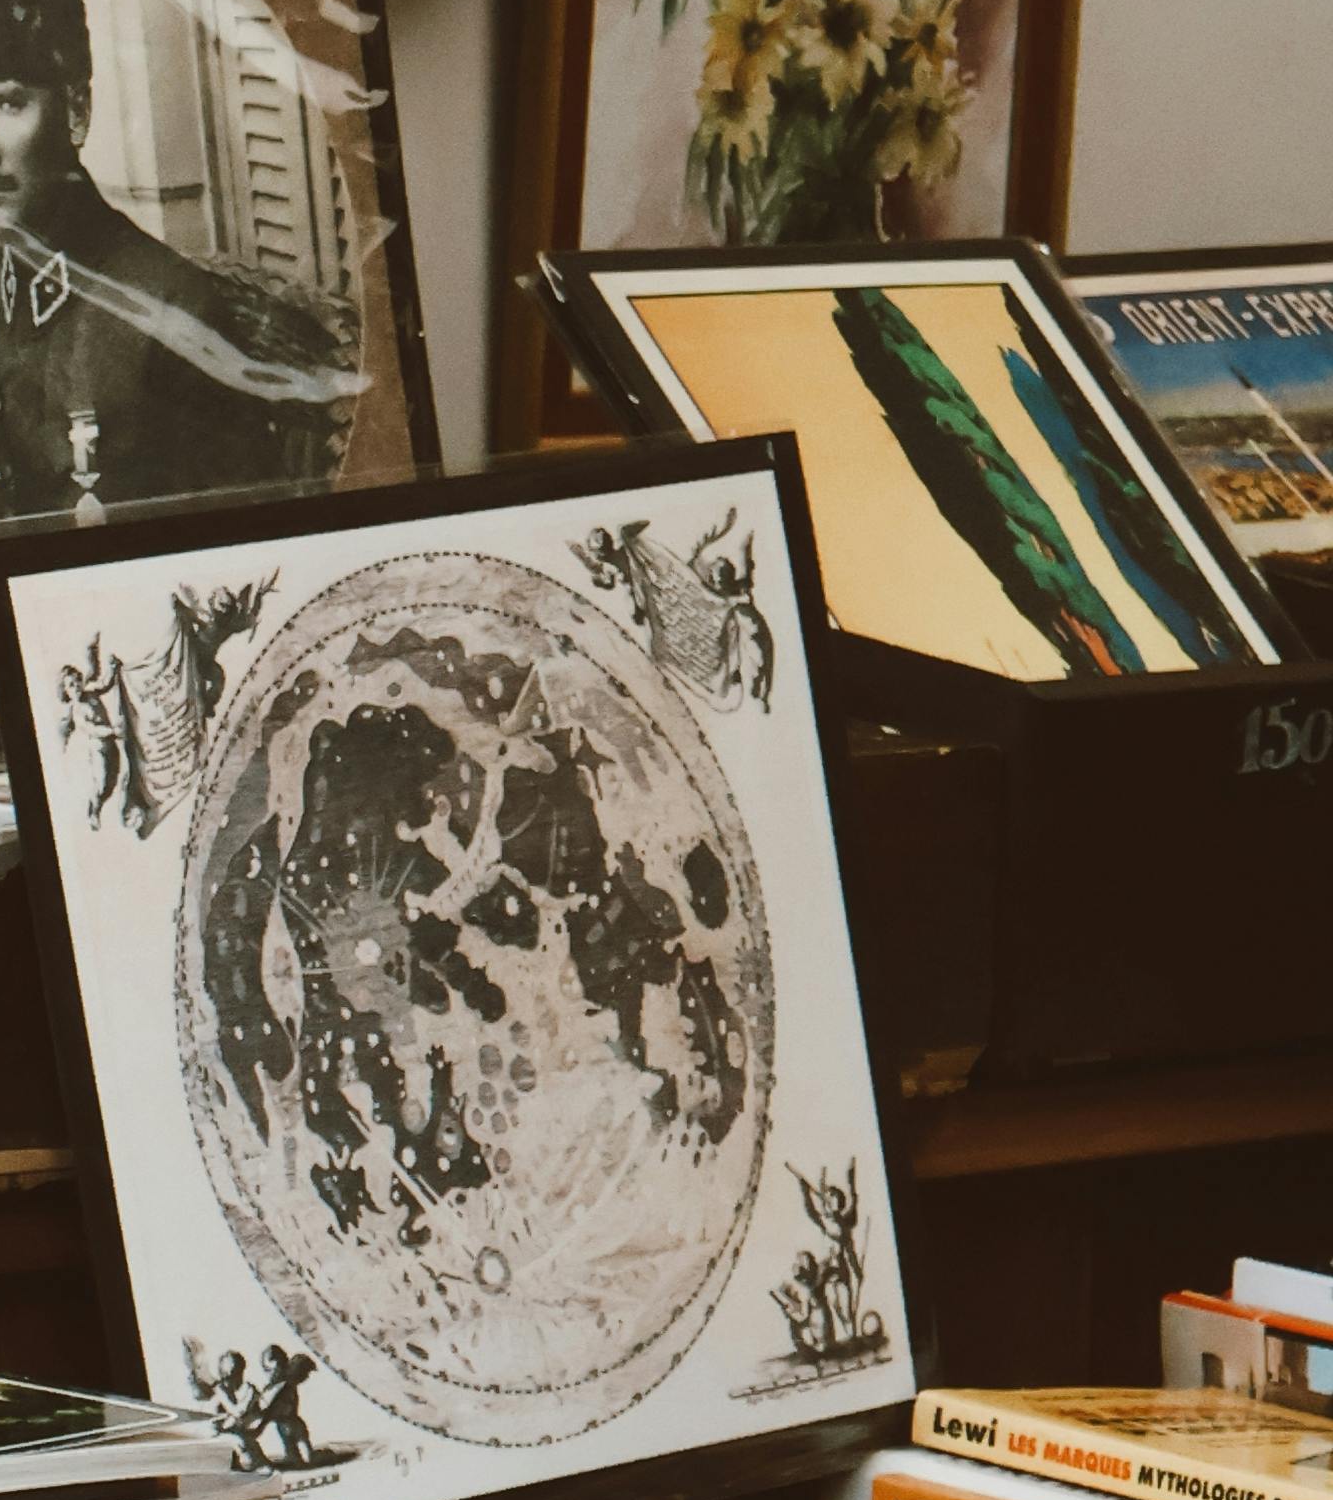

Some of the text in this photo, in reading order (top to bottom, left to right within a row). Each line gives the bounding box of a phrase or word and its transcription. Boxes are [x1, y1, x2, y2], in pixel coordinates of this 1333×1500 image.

[933, 1406, 998, 1448] Lewi
[1007, 1431, 1038, 1458] LES
[1043, 1443, 1132, 1482] MARQUES
